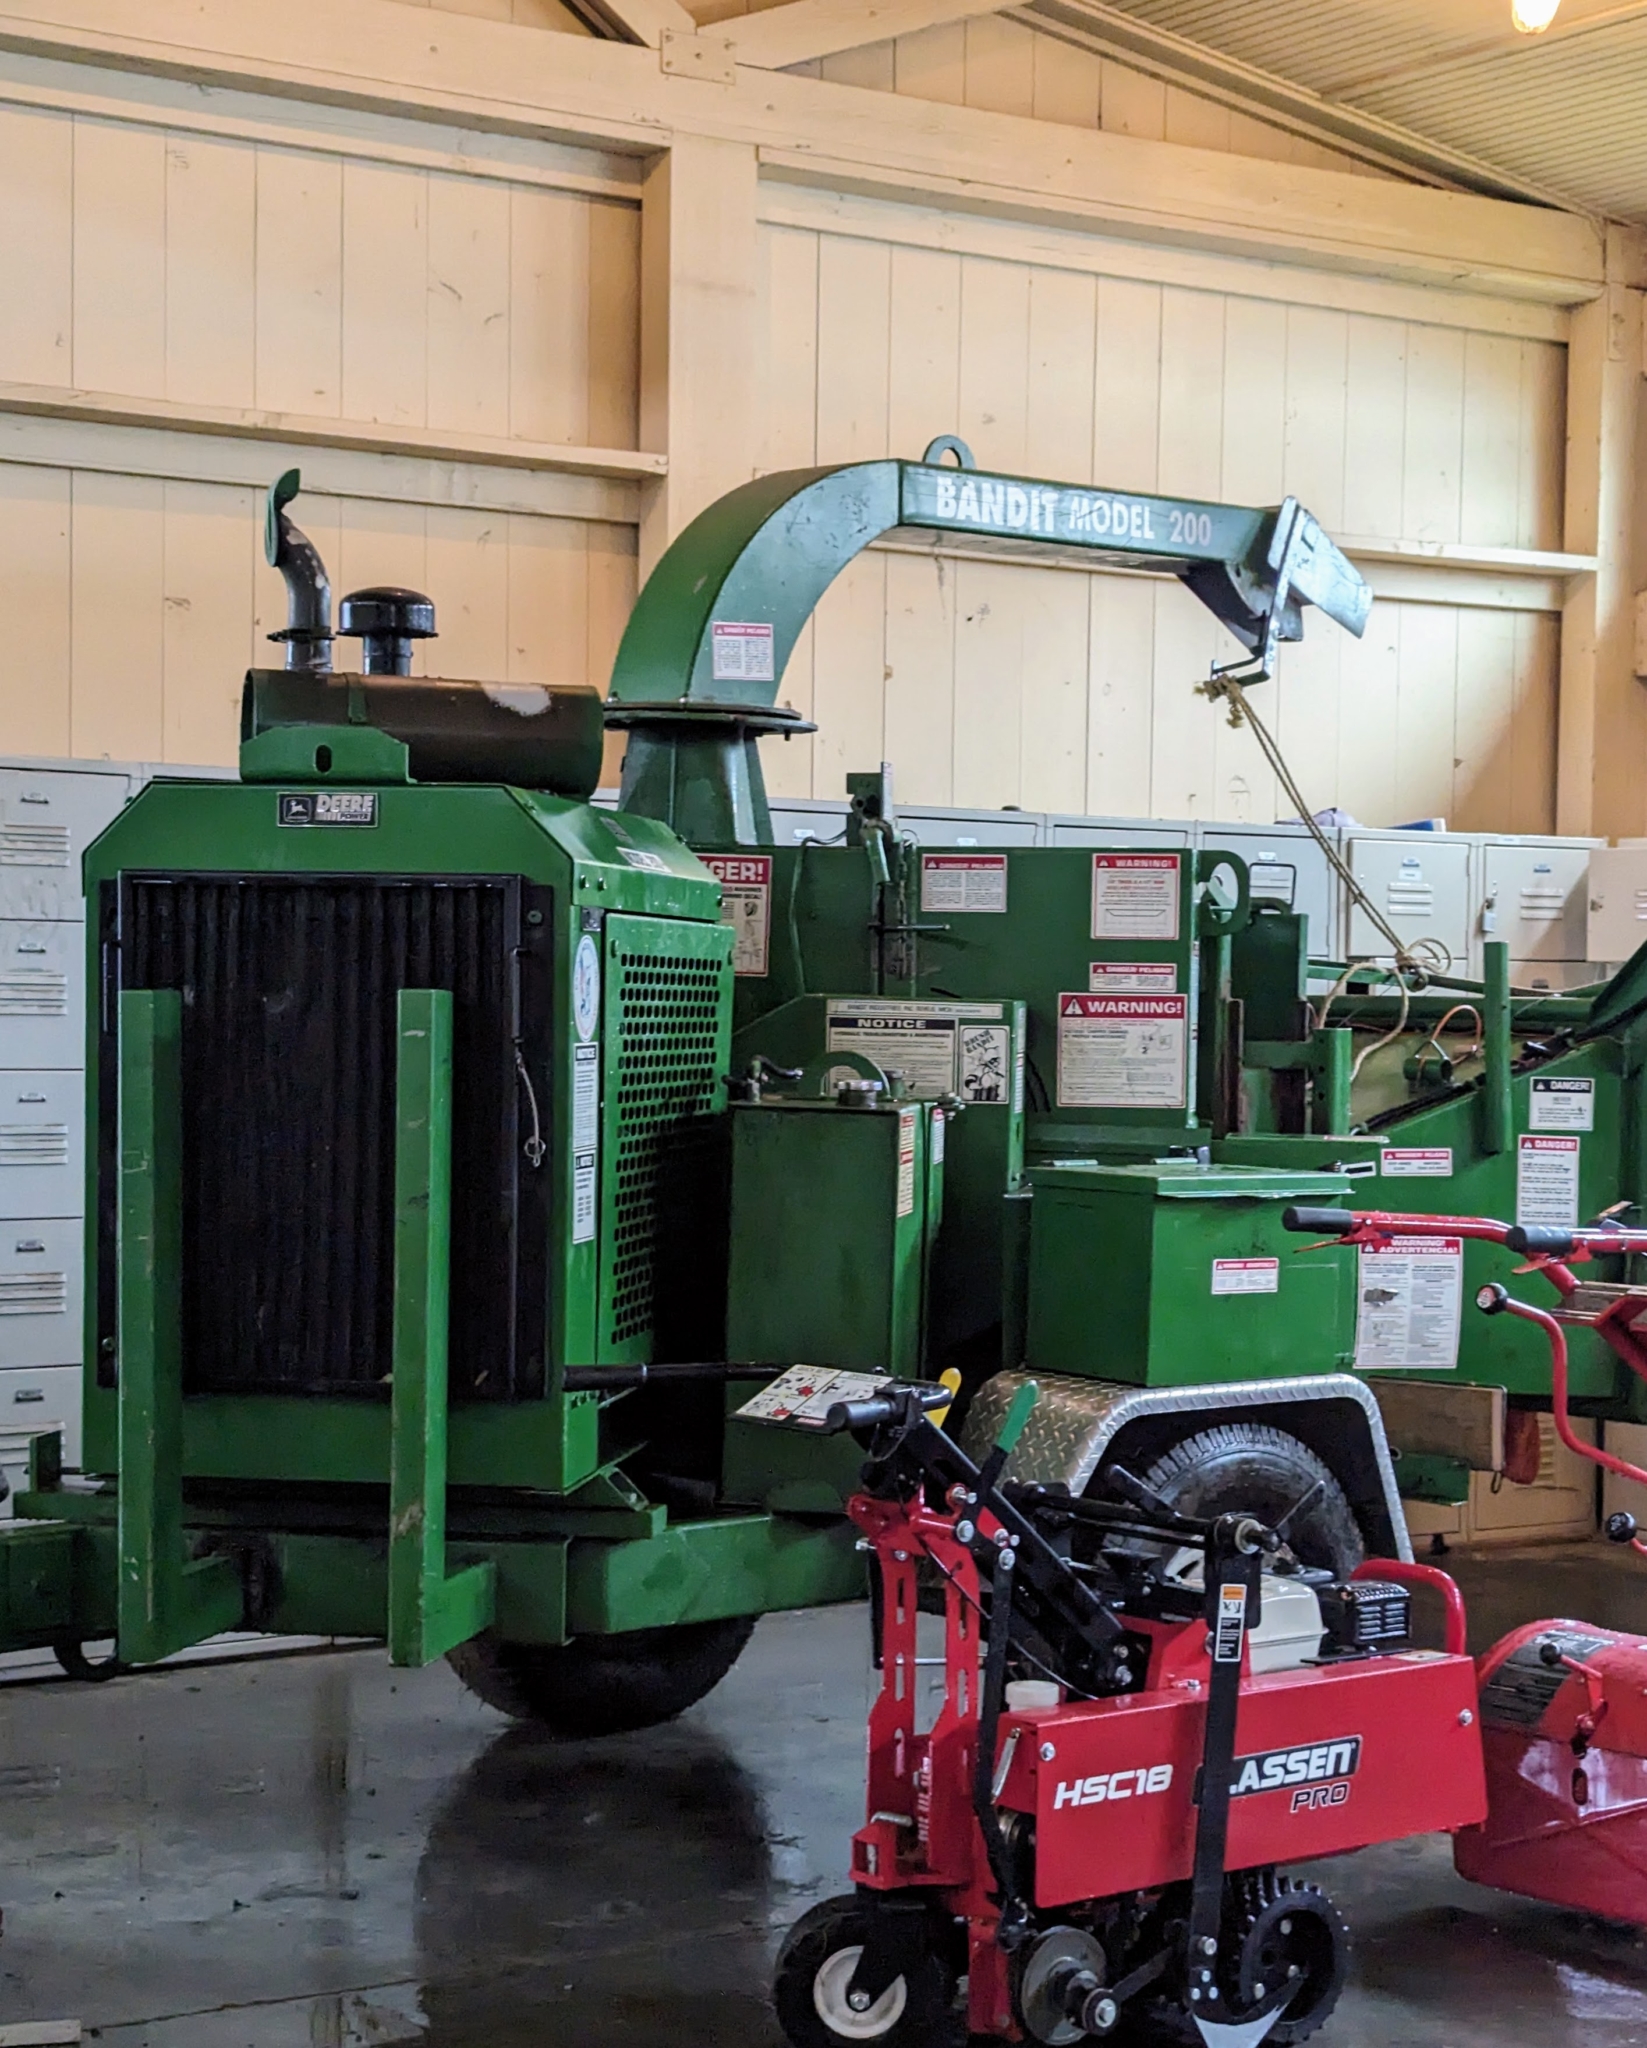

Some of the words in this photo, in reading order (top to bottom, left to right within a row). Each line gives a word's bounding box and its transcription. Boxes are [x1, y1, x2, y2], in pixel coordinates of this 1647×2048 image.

[936, 475, 1059, 532] BANDIT
[1068, 496, 1155, 539] MODEL
[1169, 510, 1211, 546] 200
[316, 794, 374, 812] DEERE
[706, 860, 764, 881] GER!
[1115, 859, 1172, 868] WARNING!
[1087, 1001, 1182, 1014] WARNING!
[857, 1018, 927, 1029] NOTICE
[1549, 1080, 1591, 1090] DANGER!
[1534, 1139, 1576, 1149] DANGER!
[1379, 1246, 1458, 1254] ADVERTENCIA!
[1228, 1741, 1353, 1795] ASSEN
[1053, 1764, 1174, 1810] HSC18
[1289, 1782, 1350, 1814] PRO
